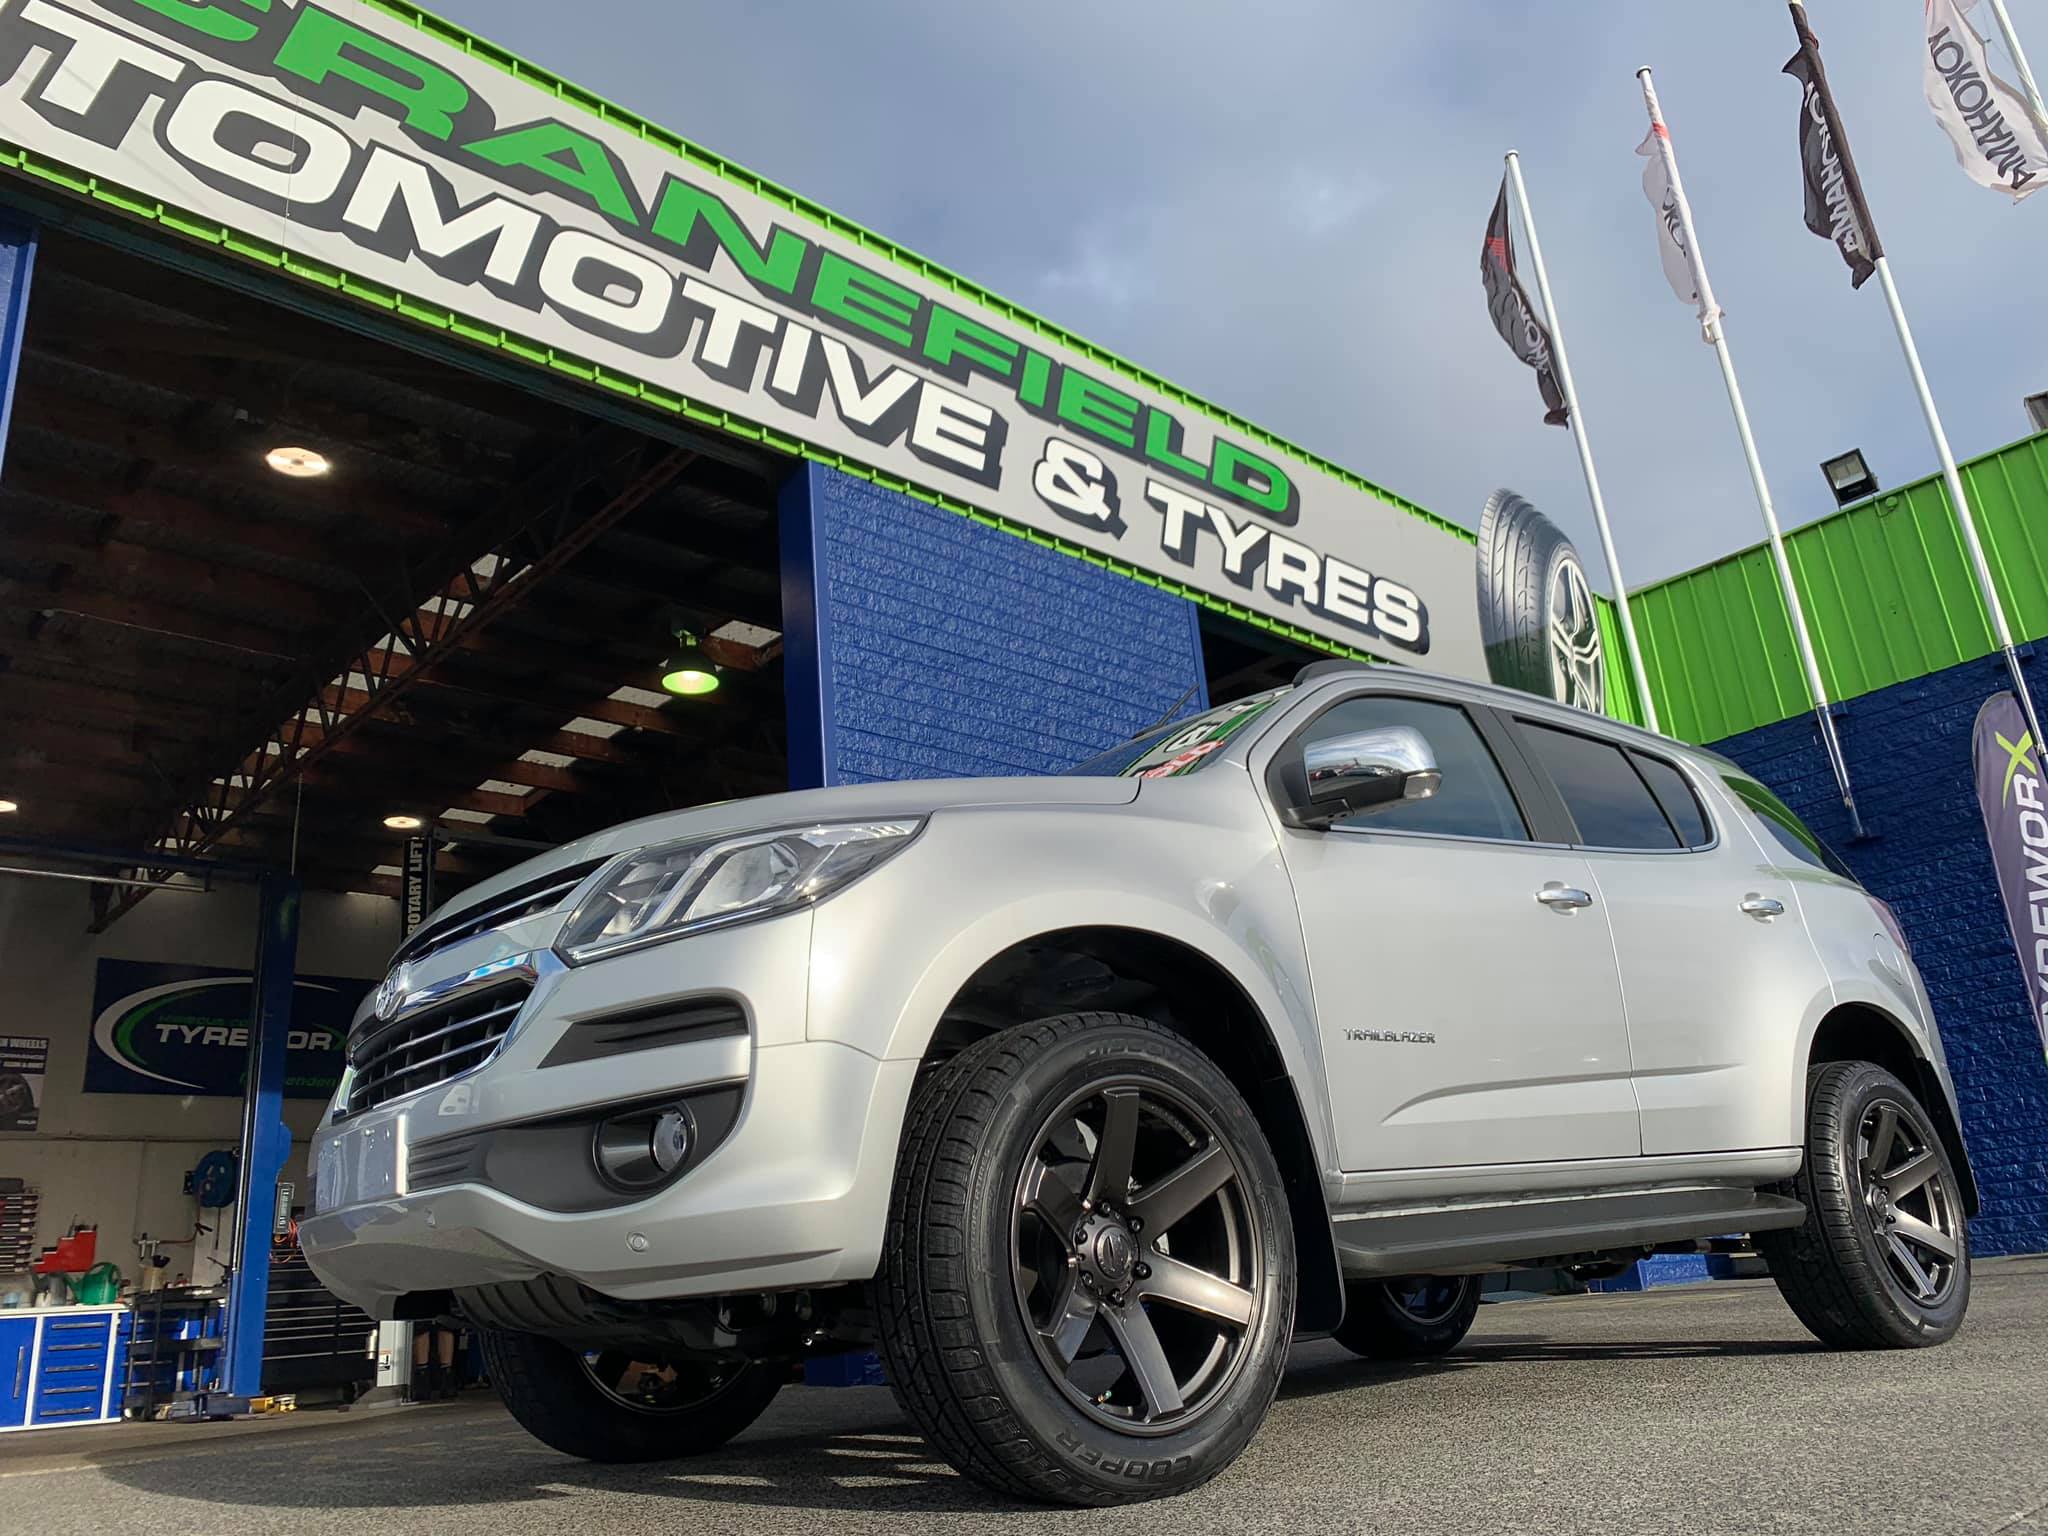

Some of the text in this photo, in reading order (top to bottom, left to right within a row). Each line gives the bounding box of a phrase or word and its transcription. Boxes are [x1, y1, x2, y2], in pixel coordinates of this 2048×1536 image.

[0, 0, 1423, 646] TOMOTIVE & TYRES
[407, 841, 424, 935] ROTARY LIFT
[1994, 729, 2048, 1042] EWORX
[155, 1023, 348, 1052] TYREOR
[1343, 1028, 1436, 1044] TRAILBLAZER
[1055, 1431, 1193, 1482] COOPER
